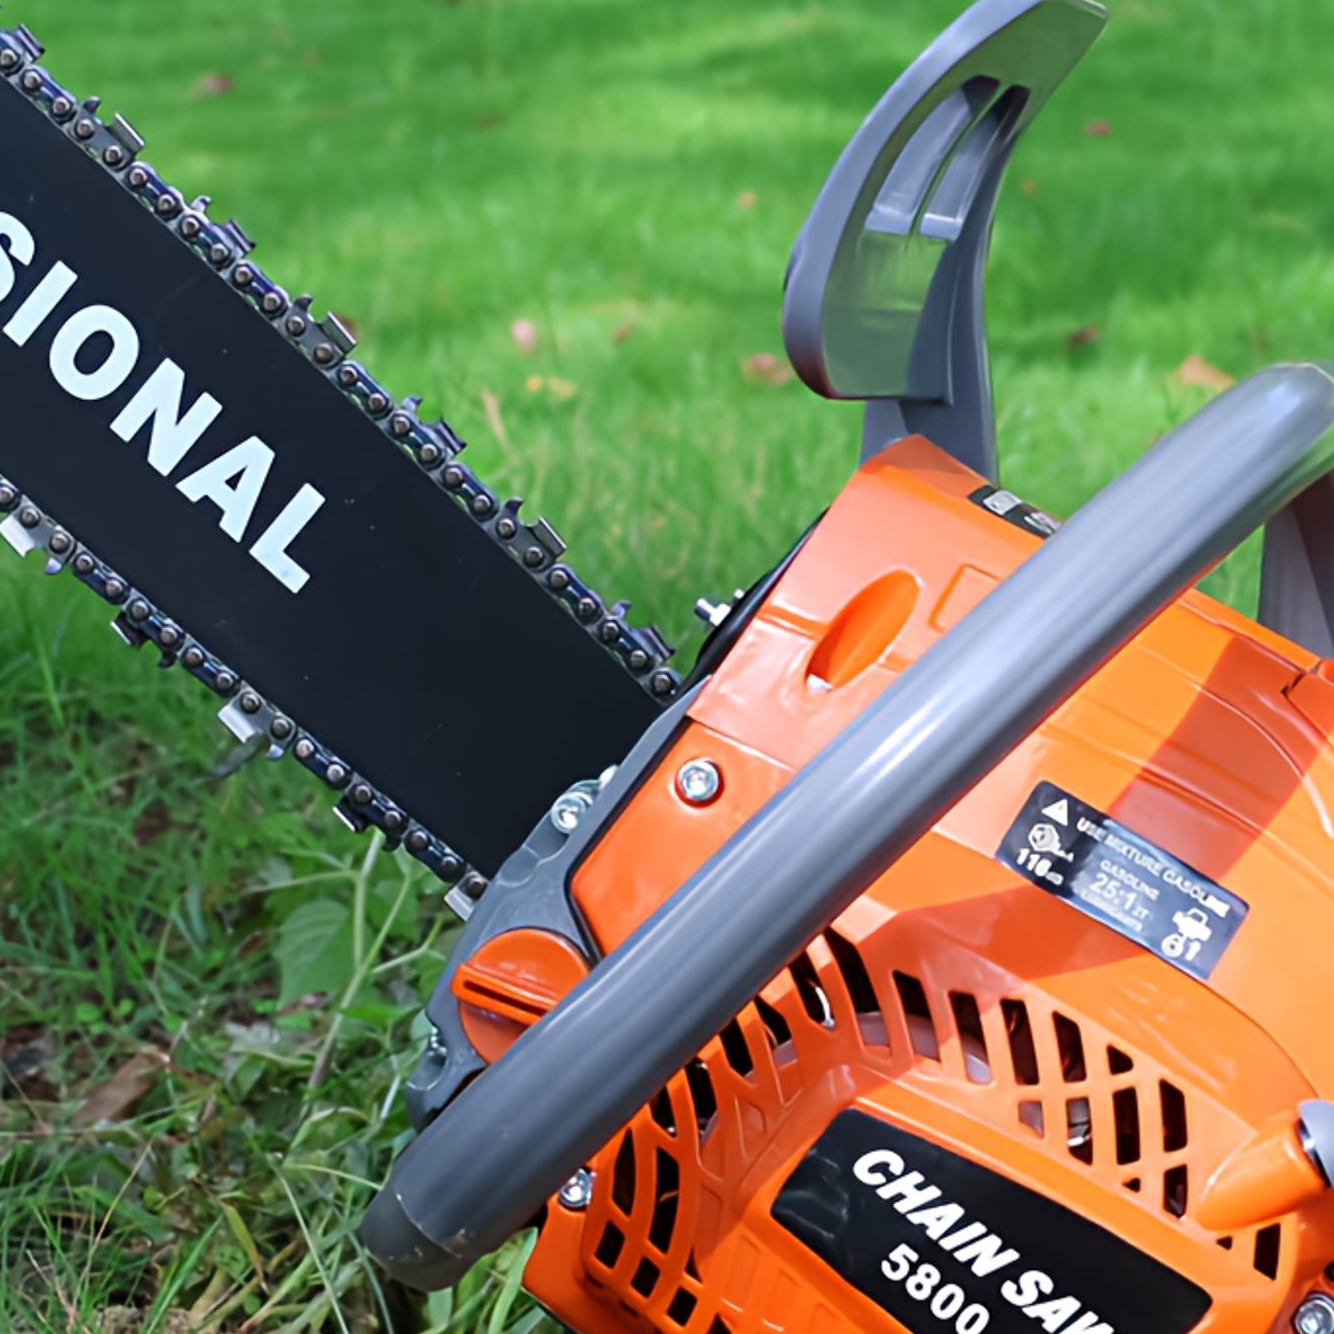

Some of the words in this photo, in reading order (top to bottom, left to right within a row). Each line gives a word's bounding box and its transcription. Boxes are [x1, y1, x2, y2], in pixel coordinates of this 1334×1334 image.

[1076, 817, 1107, 842] USE
[1104, 833, 1167, 878] MIXTURE
[1089, 873, 1138, 910] 25:1
[1099, 859, 1160, 901] GASOLINE
[852, 1149, 1020, 1277] CHAIN
